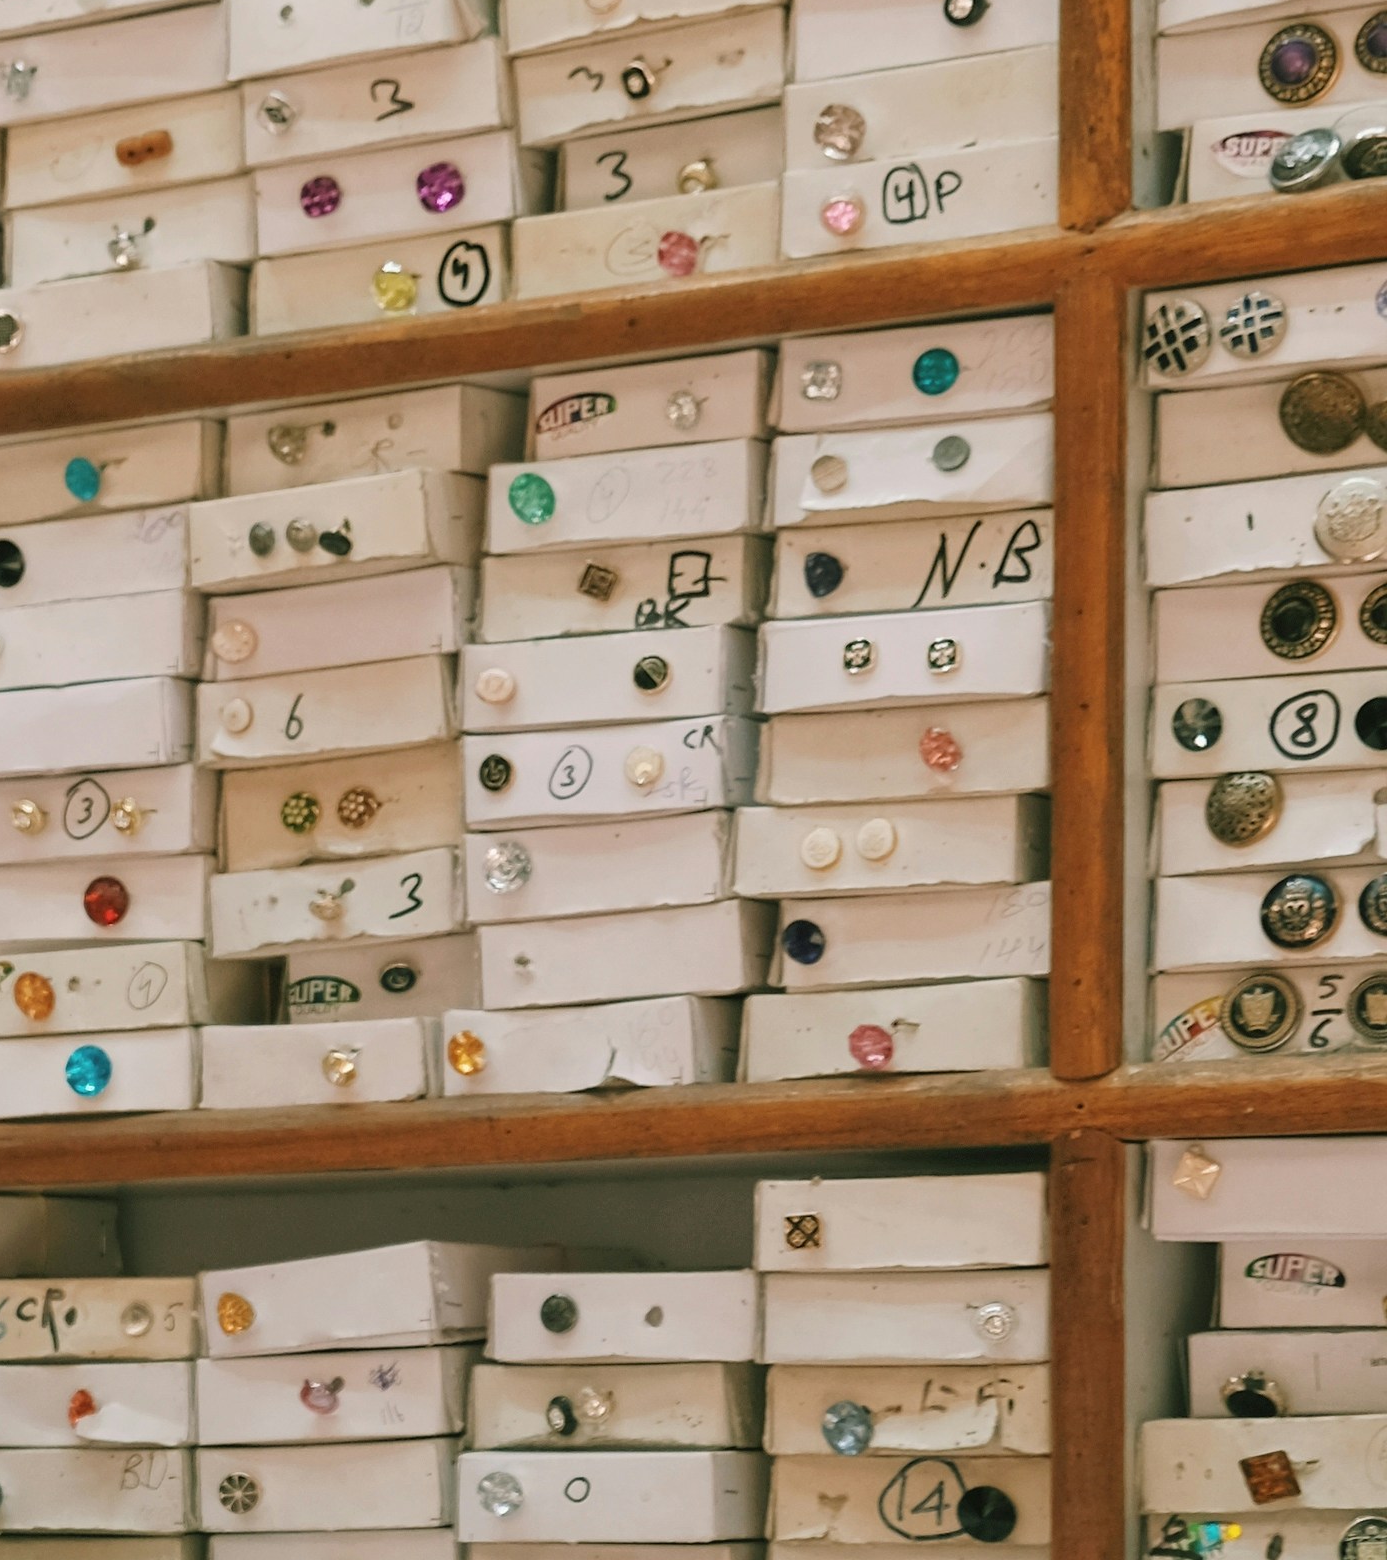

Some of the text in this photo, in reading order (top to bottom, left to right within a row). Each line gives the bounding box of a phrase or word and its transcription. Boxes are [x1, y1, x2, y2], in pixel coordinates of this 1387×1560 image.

[370, 77, 416, 121] 3
[596, 149, 634, 201] 3
[537, 394, 615, 434] SUPER
[284, 694, 306, 741] 6
[387, 872, 425, 920] 3
[1306, 1016, 1335, 1049] 6
[1247, 1256, 1344, 1288] SUPER
[897, 1473, 952, 1528] 14
